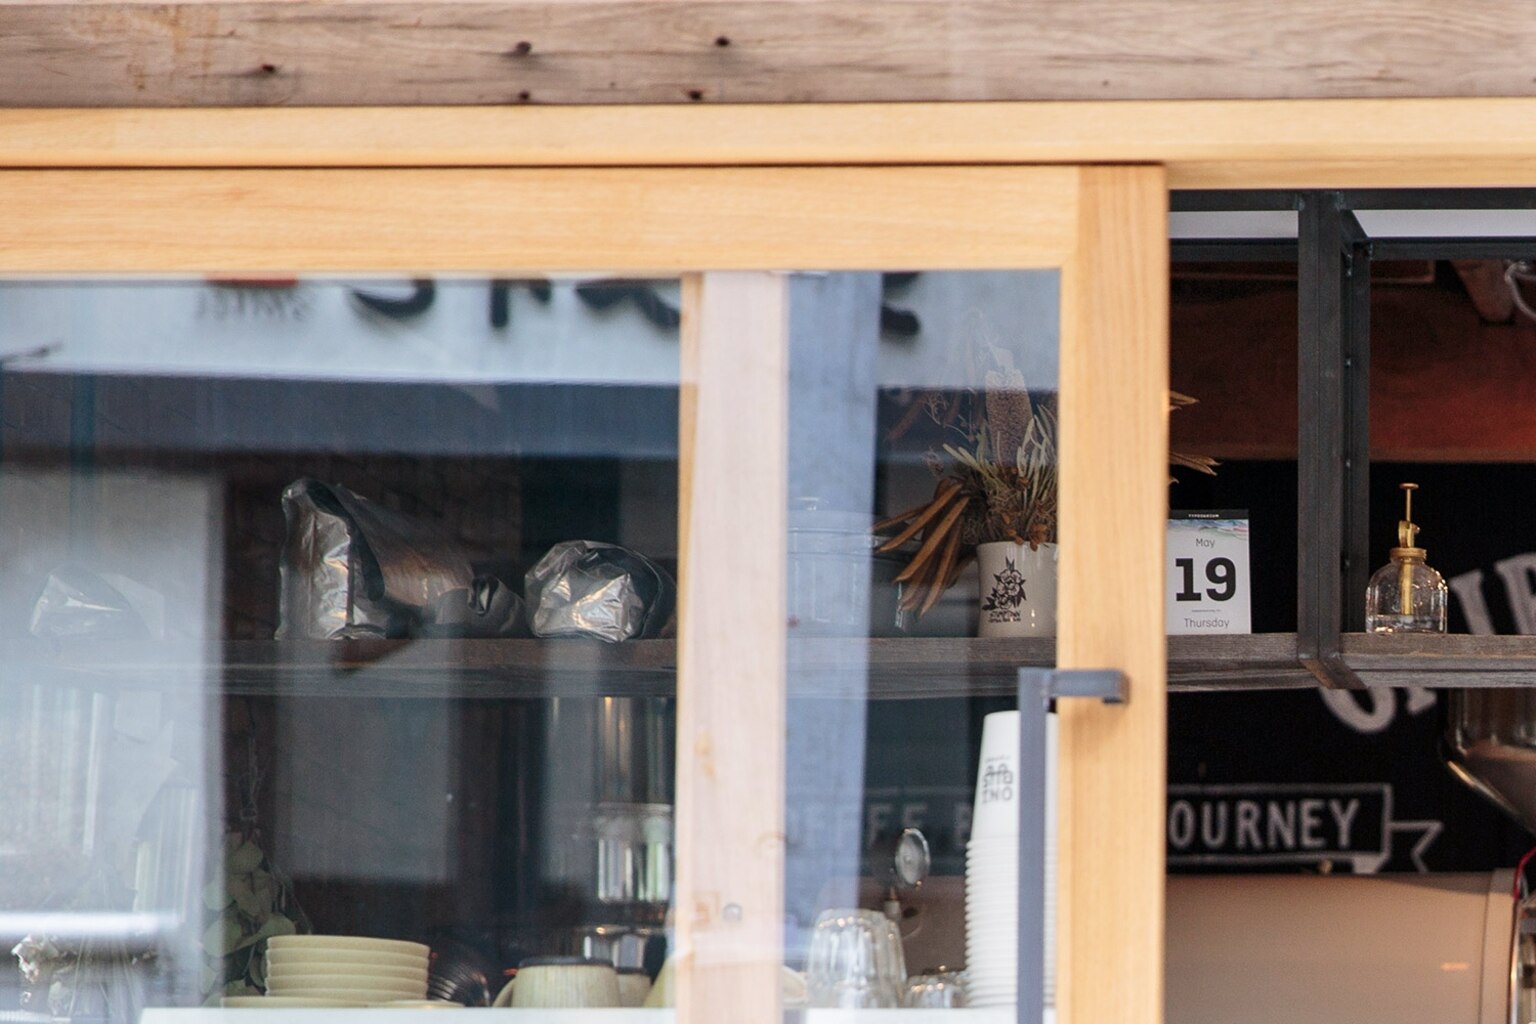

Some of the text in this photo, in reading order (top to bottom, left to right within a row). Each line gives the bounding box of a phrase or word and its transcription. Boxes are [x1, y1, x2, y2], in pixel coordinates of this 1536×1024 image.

[1195, 537, 1215, 549] May
[1175, 556, 1236, 602] 19
[1184, 618, 1230, 629] Thursday
[1168, 798, 1359, 849] OURNEY
